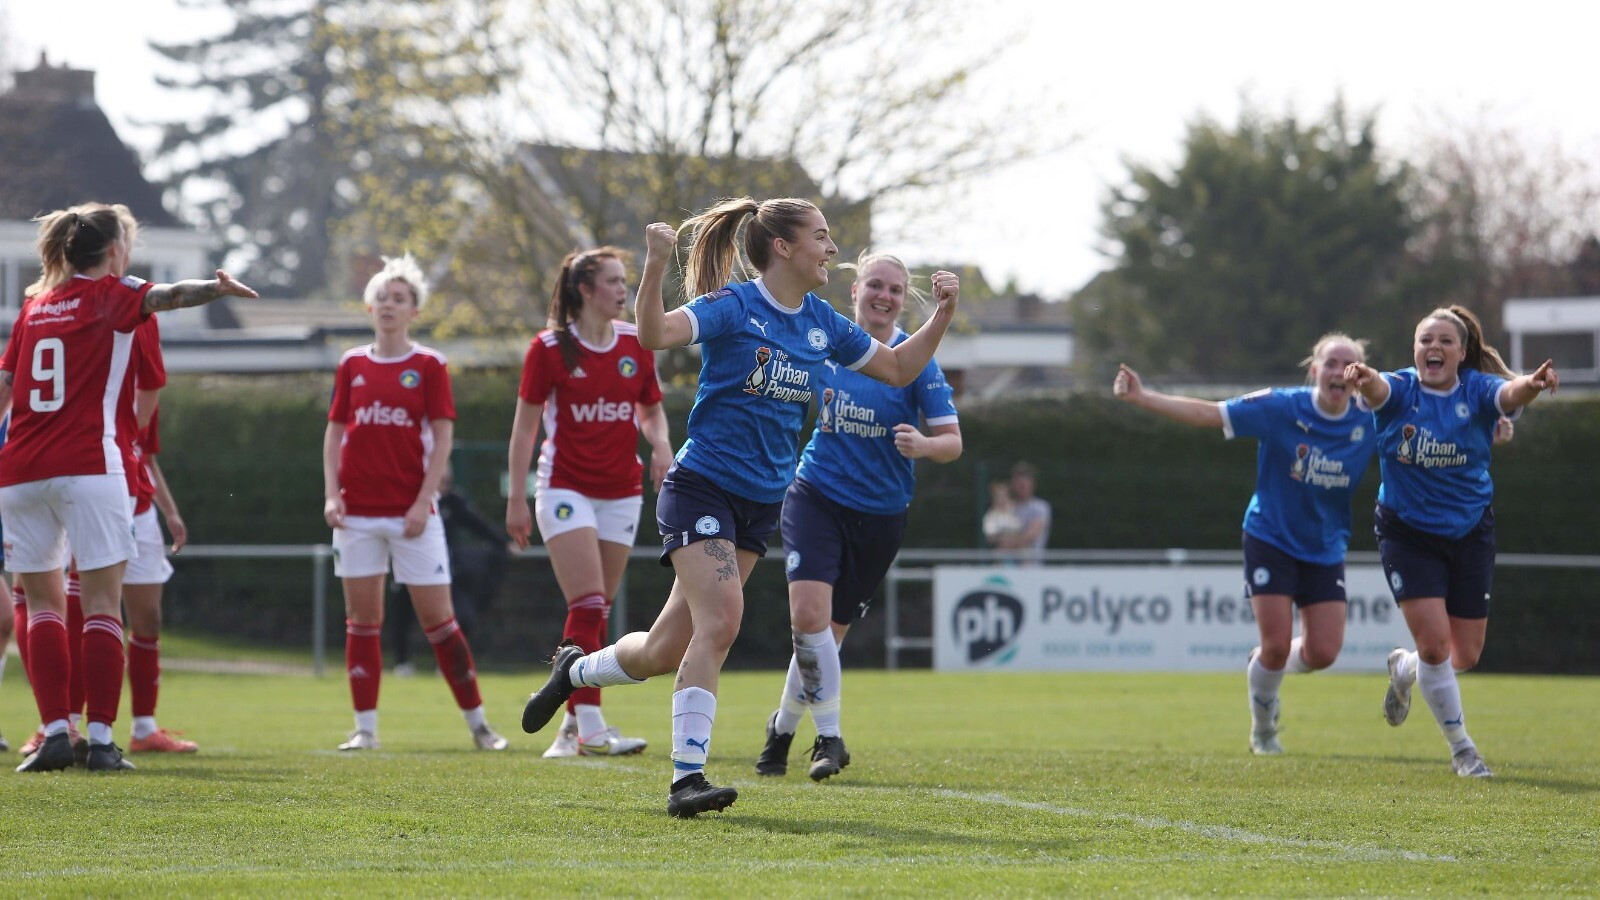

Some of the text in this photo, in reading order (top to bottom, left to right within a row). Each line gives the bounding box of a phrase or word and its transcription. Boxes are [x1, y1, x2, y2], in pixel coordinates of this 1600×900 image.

[775, 349, 788, 361] The
[30, 337, 65, 413] 9
[771, 360, 809, 386] Urban
[764, 379, 812, 403] Penguin
[355, 400, 414, 428] wise.
[570, 396, 632, 423] wise
[835, 399, 875, 423] Urban
[835, 416, 887, 438] Penguin
[1417, 435, 1456, 456] Urban
[1308, 453, 1343, 475] Urban
[1416, 451, 1467, 469] Penguin
[1305, 469, 1350, 490] Penguin
[957, 595, 1014, 647] ph
[1040, 586, 1172, 635] Polyco
